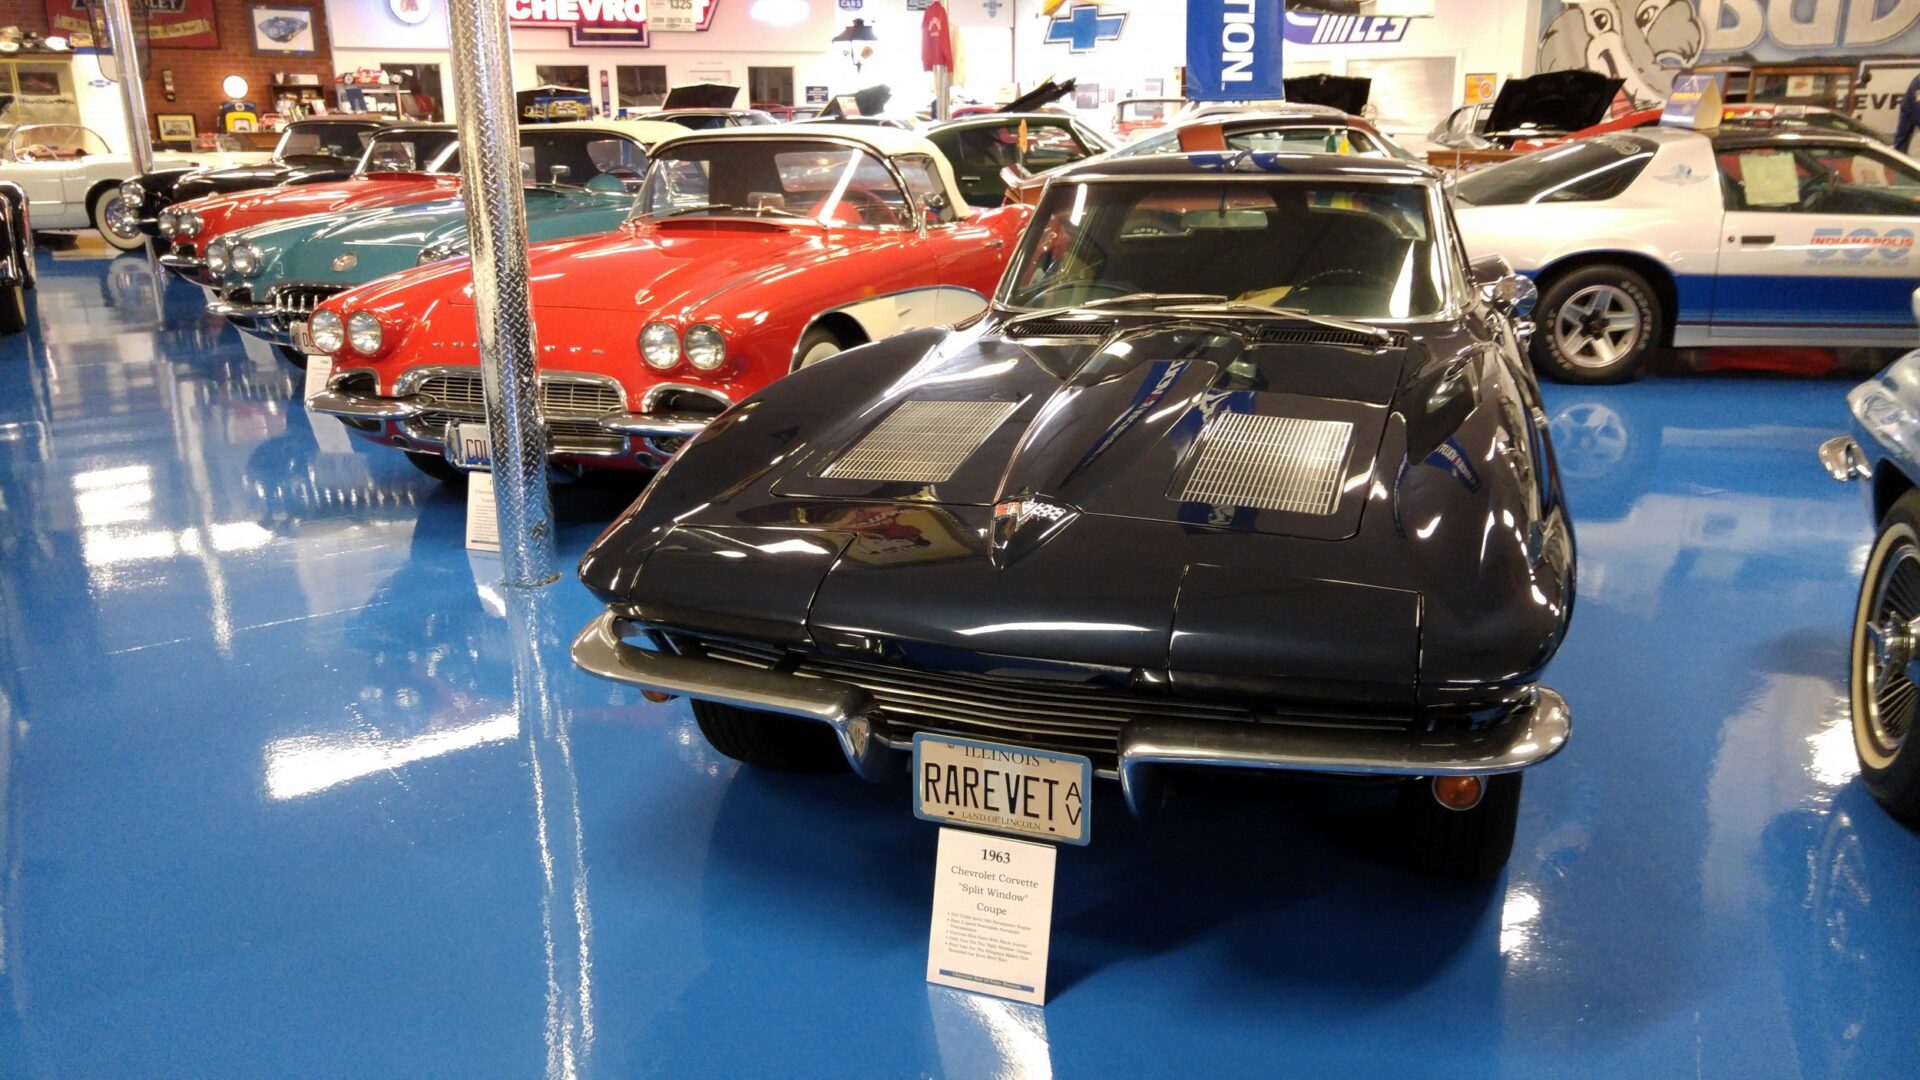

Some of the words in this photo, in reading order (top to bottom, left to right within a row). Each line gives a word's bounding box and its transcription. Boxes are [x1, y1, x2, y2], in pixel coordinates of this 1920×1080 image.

[964, 746, 1040, 767] ILLINOIS
[925, 762, 1059, 821] RAREVET
[962, 811, 986, 823] LAND
[987, 815, 1000, 824] OF
[1001, 817, 1041, 830] LINCOLN
[981, 849, 1011, 864] 1963
[951, 865, 996, 881] Chevrolet
[998, 874, 1039, 889] Corvette
[976, 902, 1007, 917] Coupe
